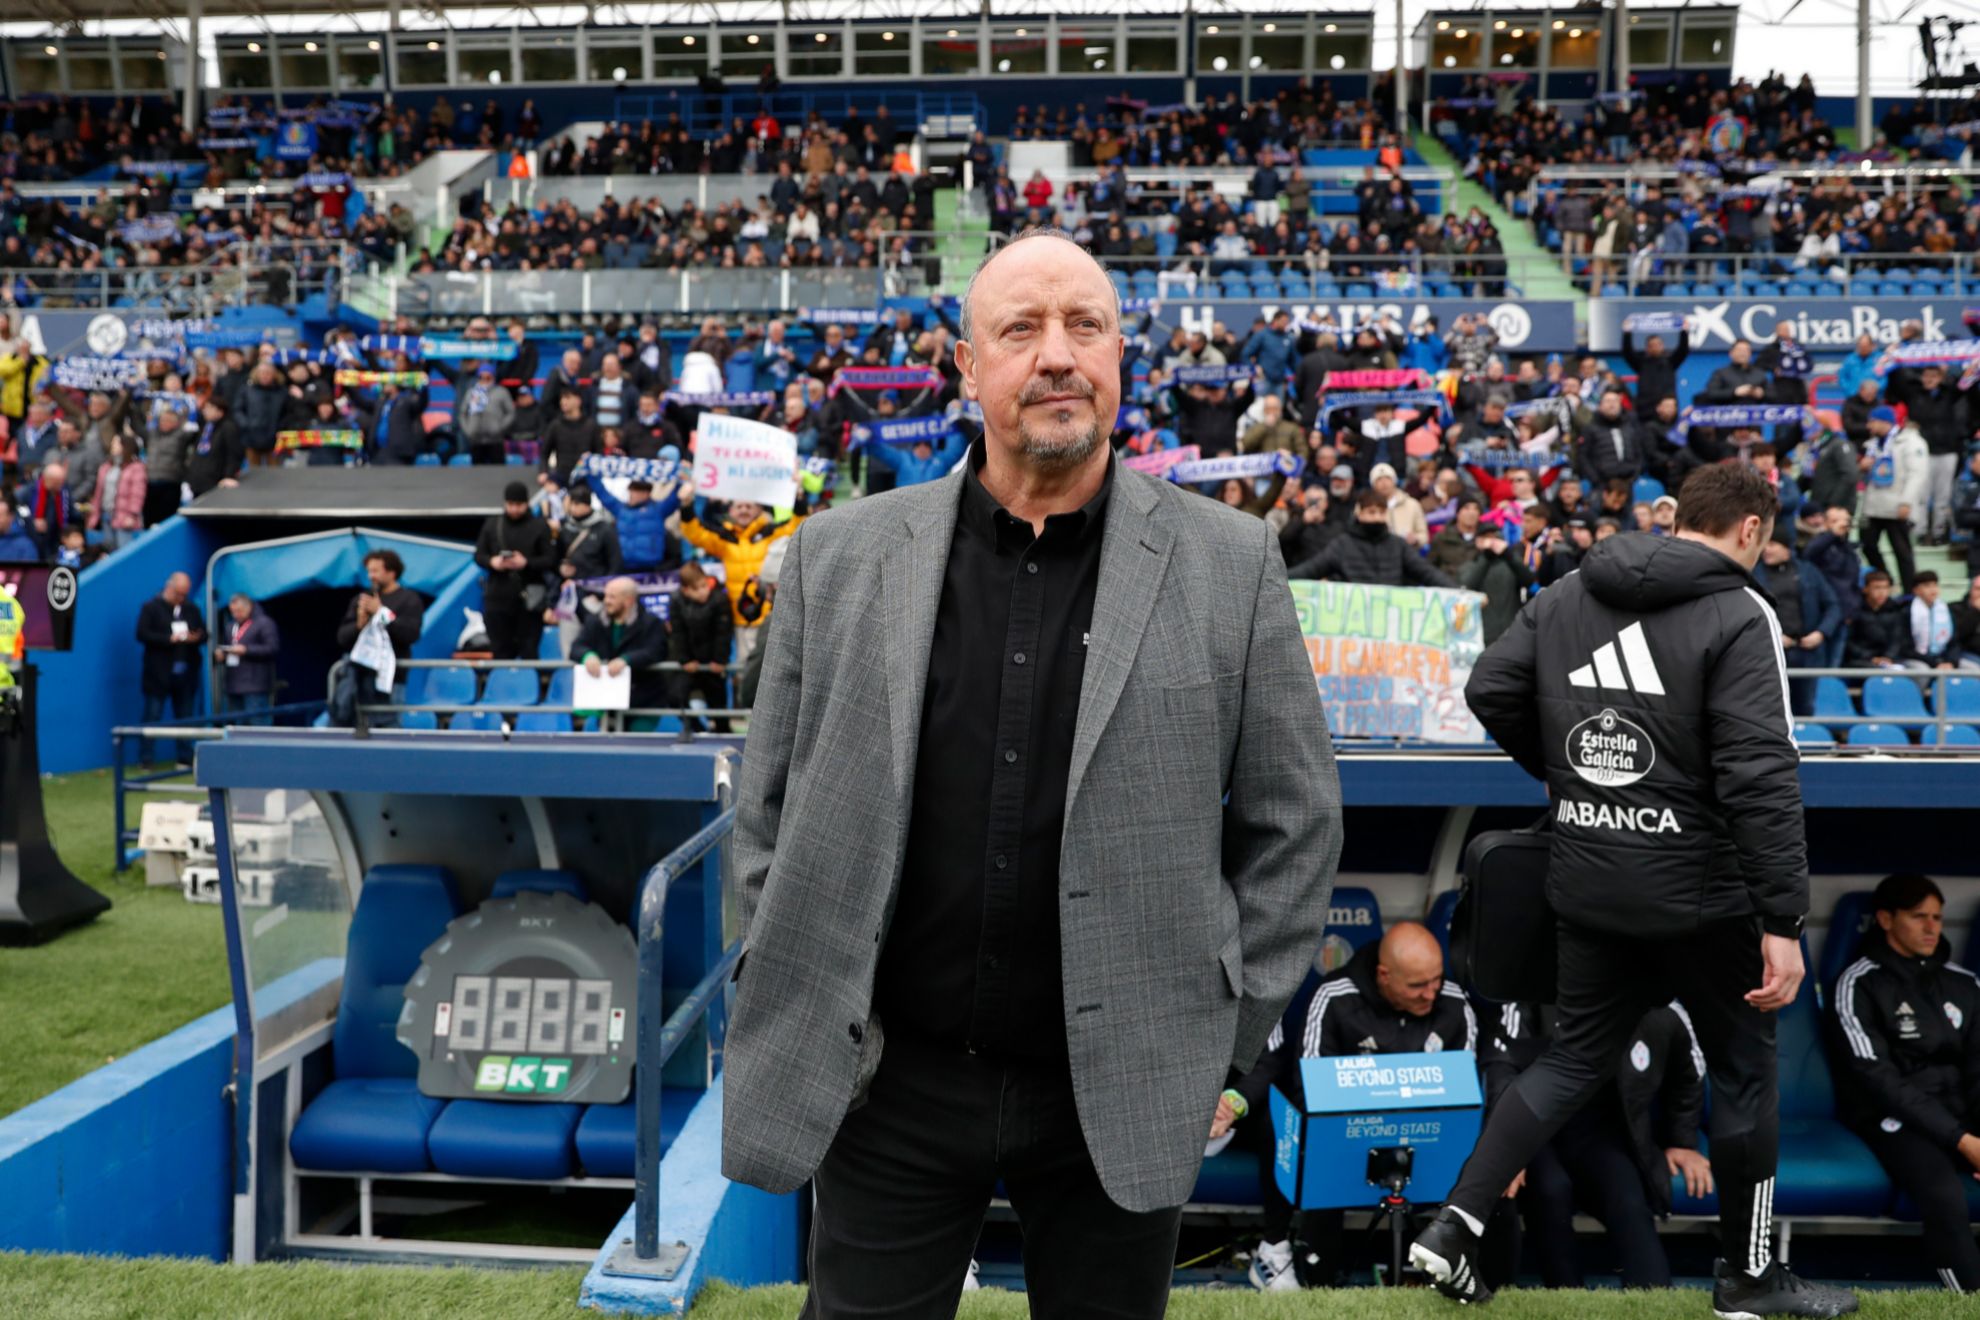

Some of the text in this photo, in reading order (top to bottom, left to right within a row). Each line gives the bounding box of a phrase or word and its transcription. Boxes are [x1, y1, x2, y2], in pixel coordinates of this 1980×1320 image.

[1740, 303, 1945, 344] CixaBak
[881, 420, 926, 439] GETAFE
[700, 461, 719, 490] 3
[1339, 639, 1451, 688] CAMISETA
[1579, 730, 1638, 752] Estrella
[1580, 747, 1635, 770] Galicia
[1557, 799, 1682, 833] ABANCA
[519, 917, 556, 927] BKT
[478, 1061, 568, 1089] BKT
[1334, 1058, 1376, 1070] LALIGA
[1337, 1066, 1443, 1087] BEYOND STATS
[1346, 1122, 1441, 1139] BEYOND STATS
[1347, 1116, 1384, 1126] LALIGA
